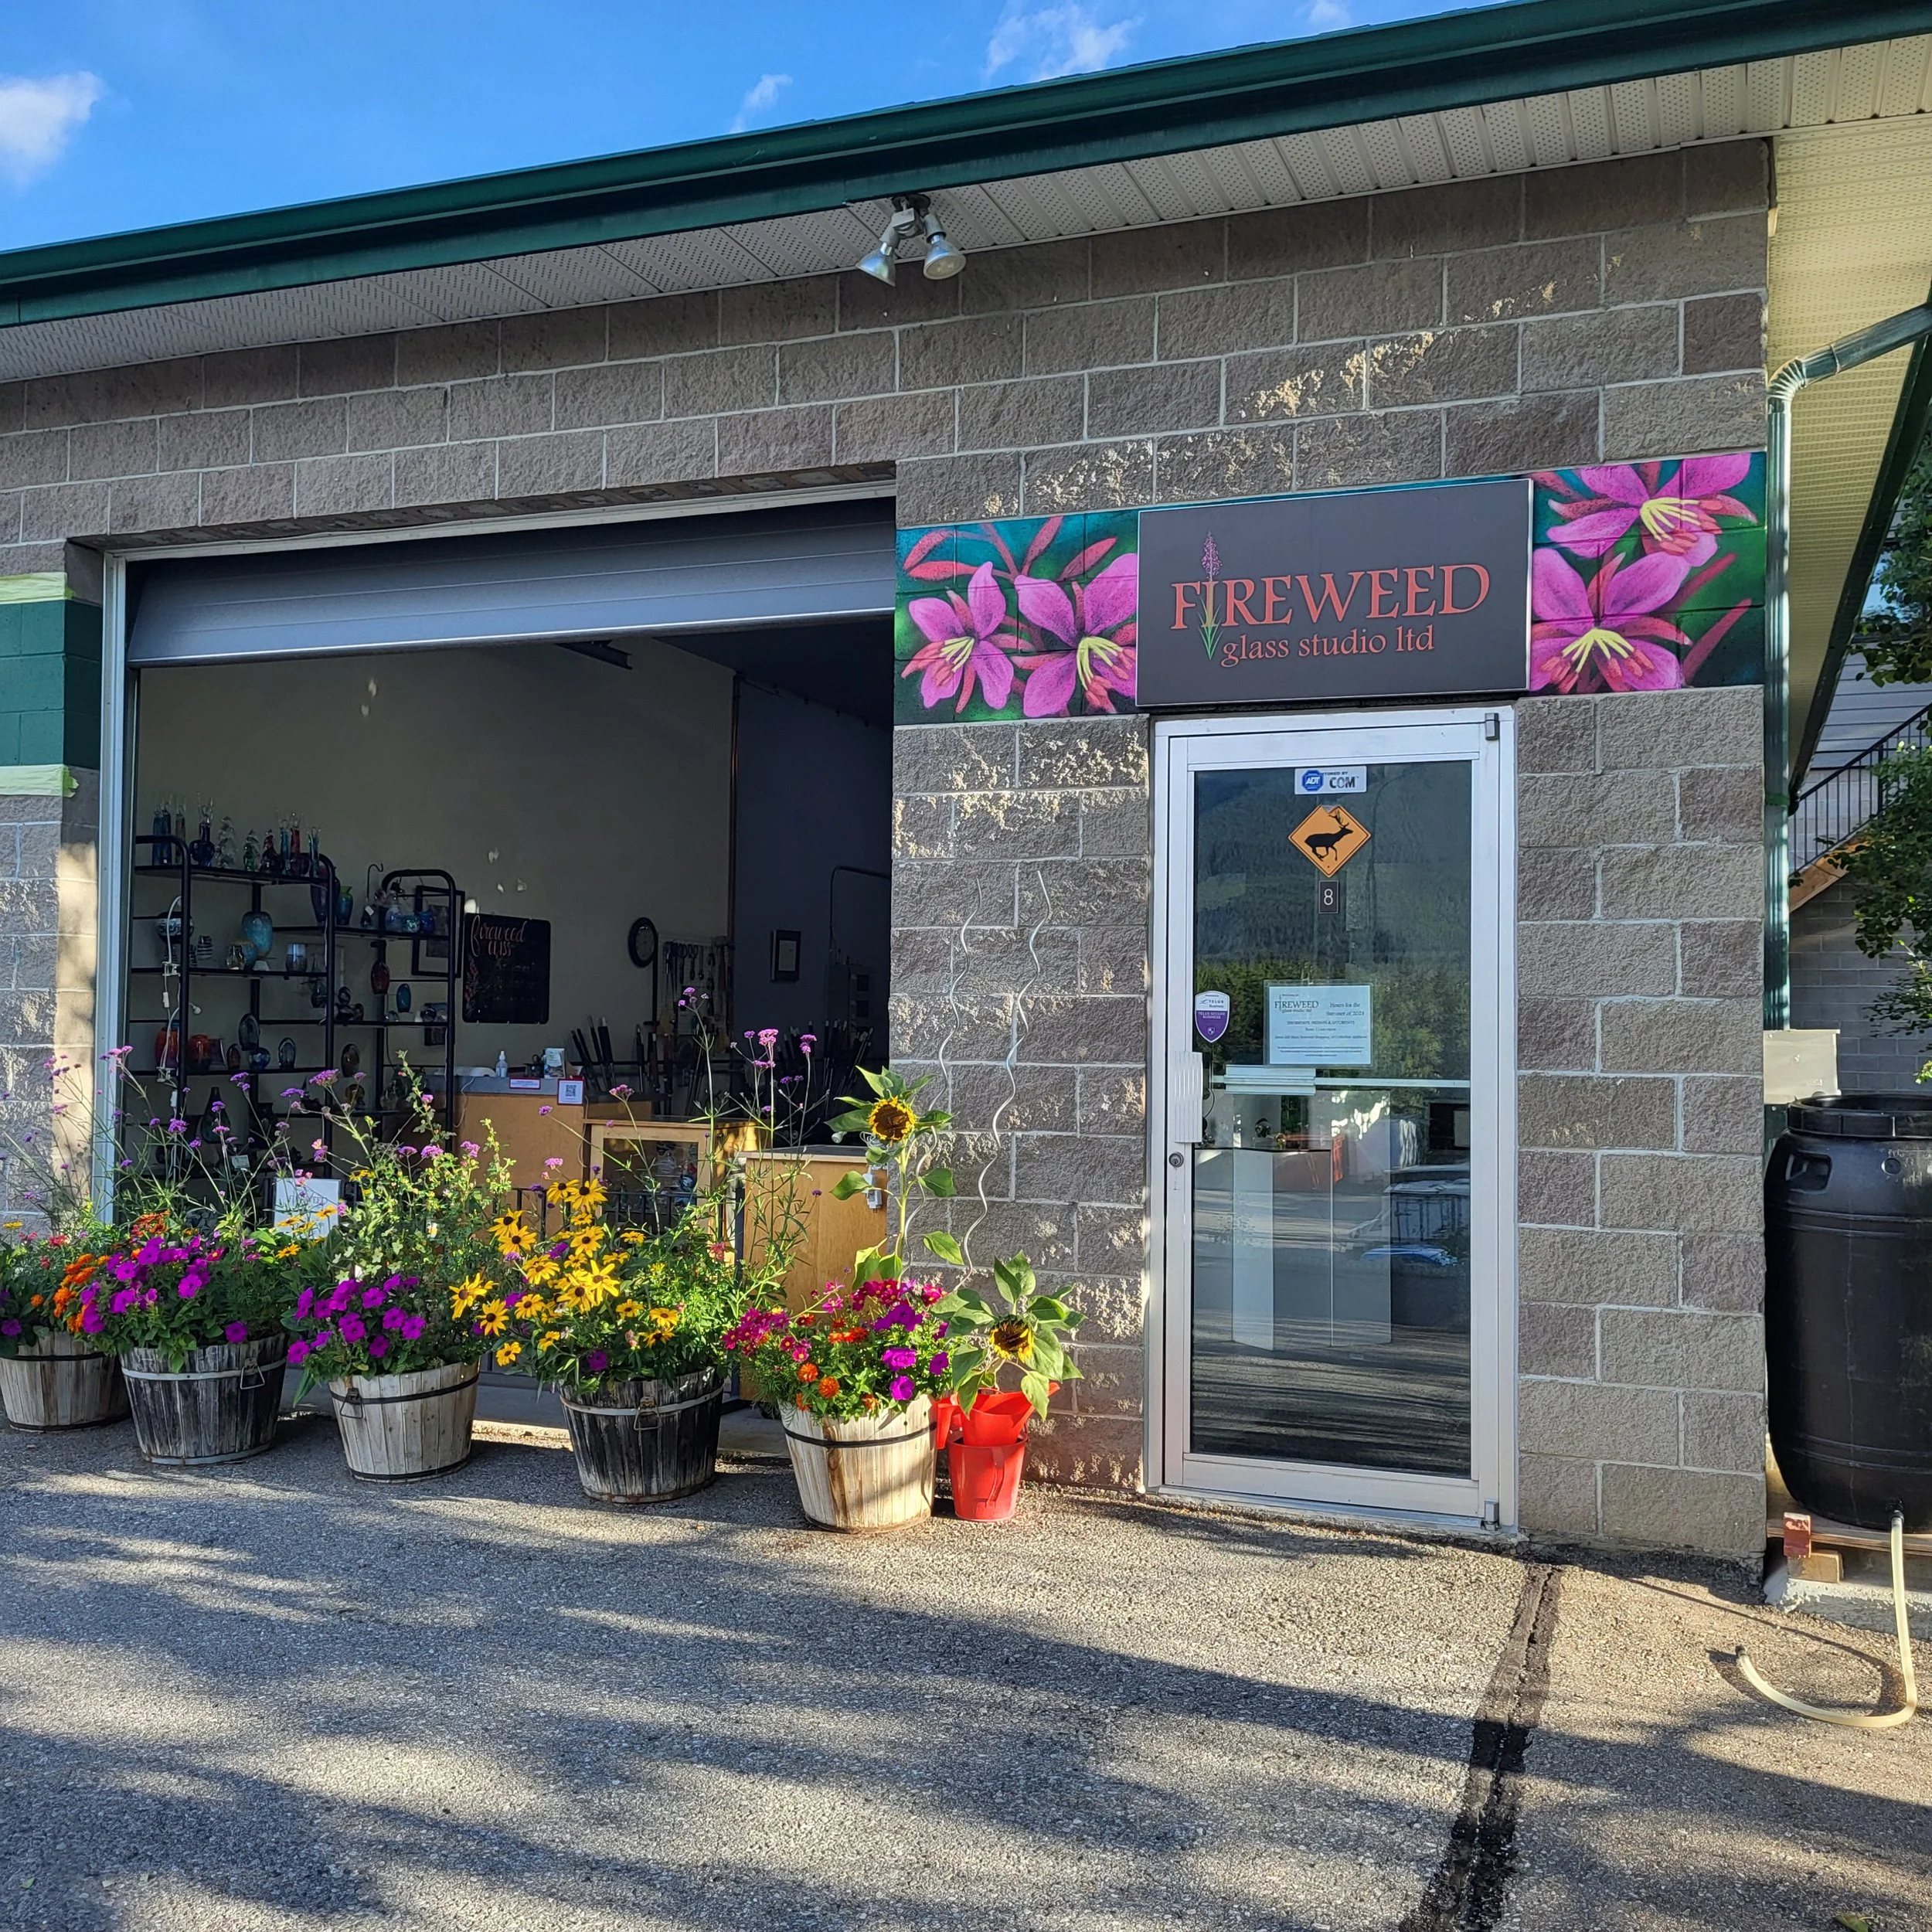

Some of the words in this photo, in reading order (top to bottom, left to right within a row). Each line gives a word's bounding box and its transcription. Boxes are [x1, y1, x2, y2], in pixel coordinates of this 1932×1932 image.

[1171, 562, 1491, 631] FIREWEED
[1220, 635, 1290, 668] glass
[1298, 627, 1386, 657] studio
[1396, 624, 1434, 653] ltd
[1305, 777, 1321, 785] ADT
[1323, 888, 1334, 906] 8
